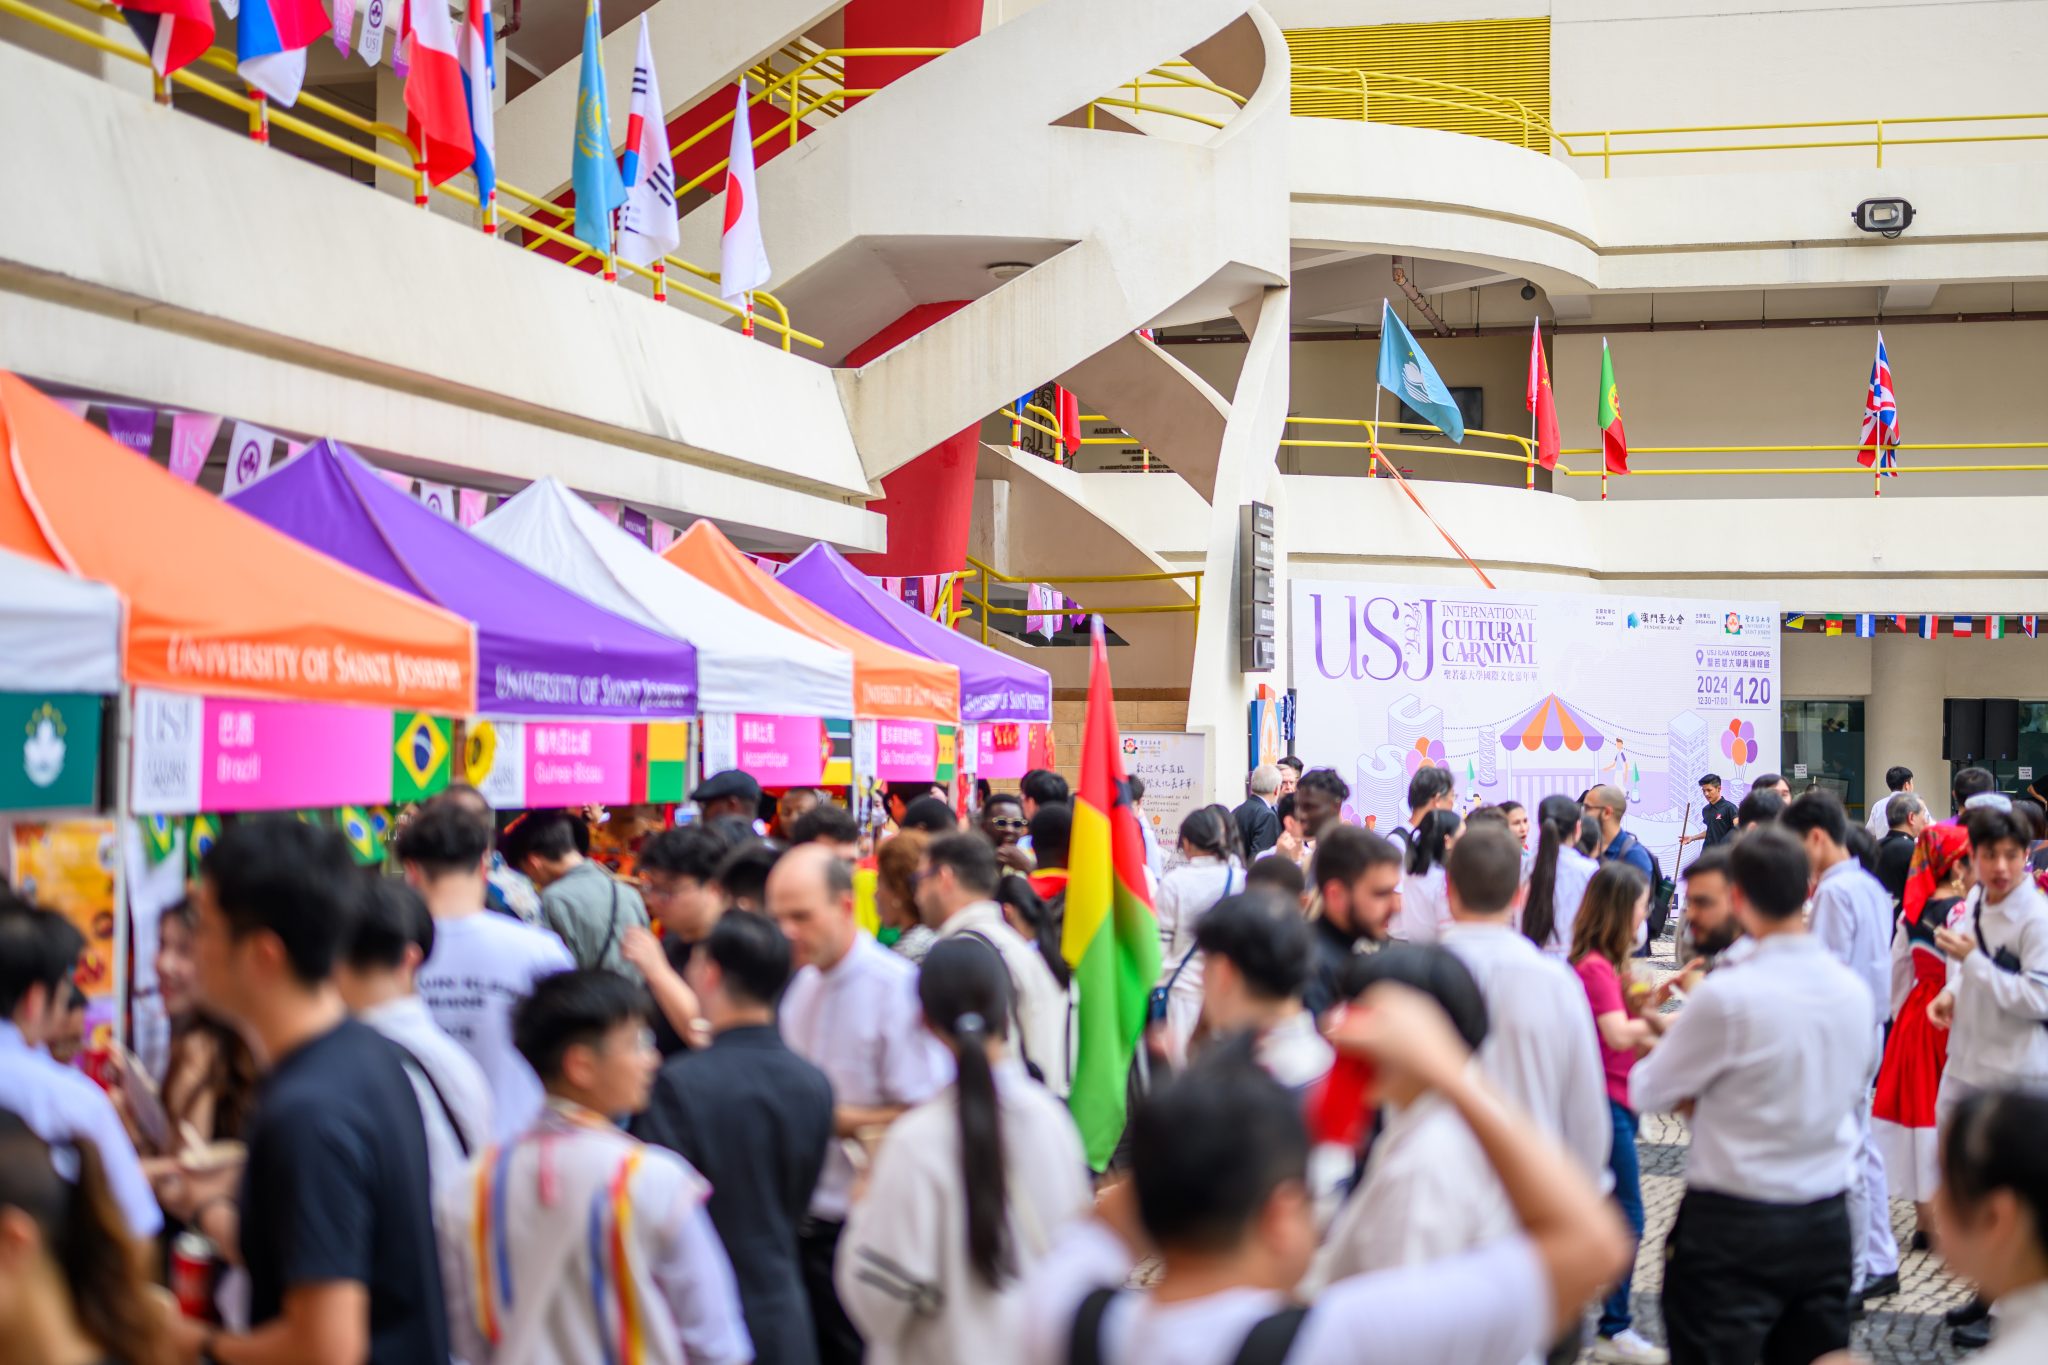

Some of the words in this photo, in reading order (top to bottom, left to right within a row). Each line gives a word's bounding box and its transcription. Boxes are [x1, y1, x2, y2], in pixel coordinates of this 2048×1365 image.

[1442, 605, 1537, 621] INTERNATIONAL
[1309, 594, 1437, 681] USJ
[1442, 619, 1538, 647] CULTURAL
[167, 634, 300, 681] UNIVERSITY
[301, 647, 331, 683] OF
[333, 645, 393, 687] SAINT
[393, 651, 462, 694] JOSEPH
[1442, 641, 1538, 668] CARNIVAL
[496, 664, 579, 704] UNIVERSITY
[600, 673, 641, 707] SAINT
[1697, 675, 1728, 694] 2024
[1733, 677, 1771, 704] 4.20
